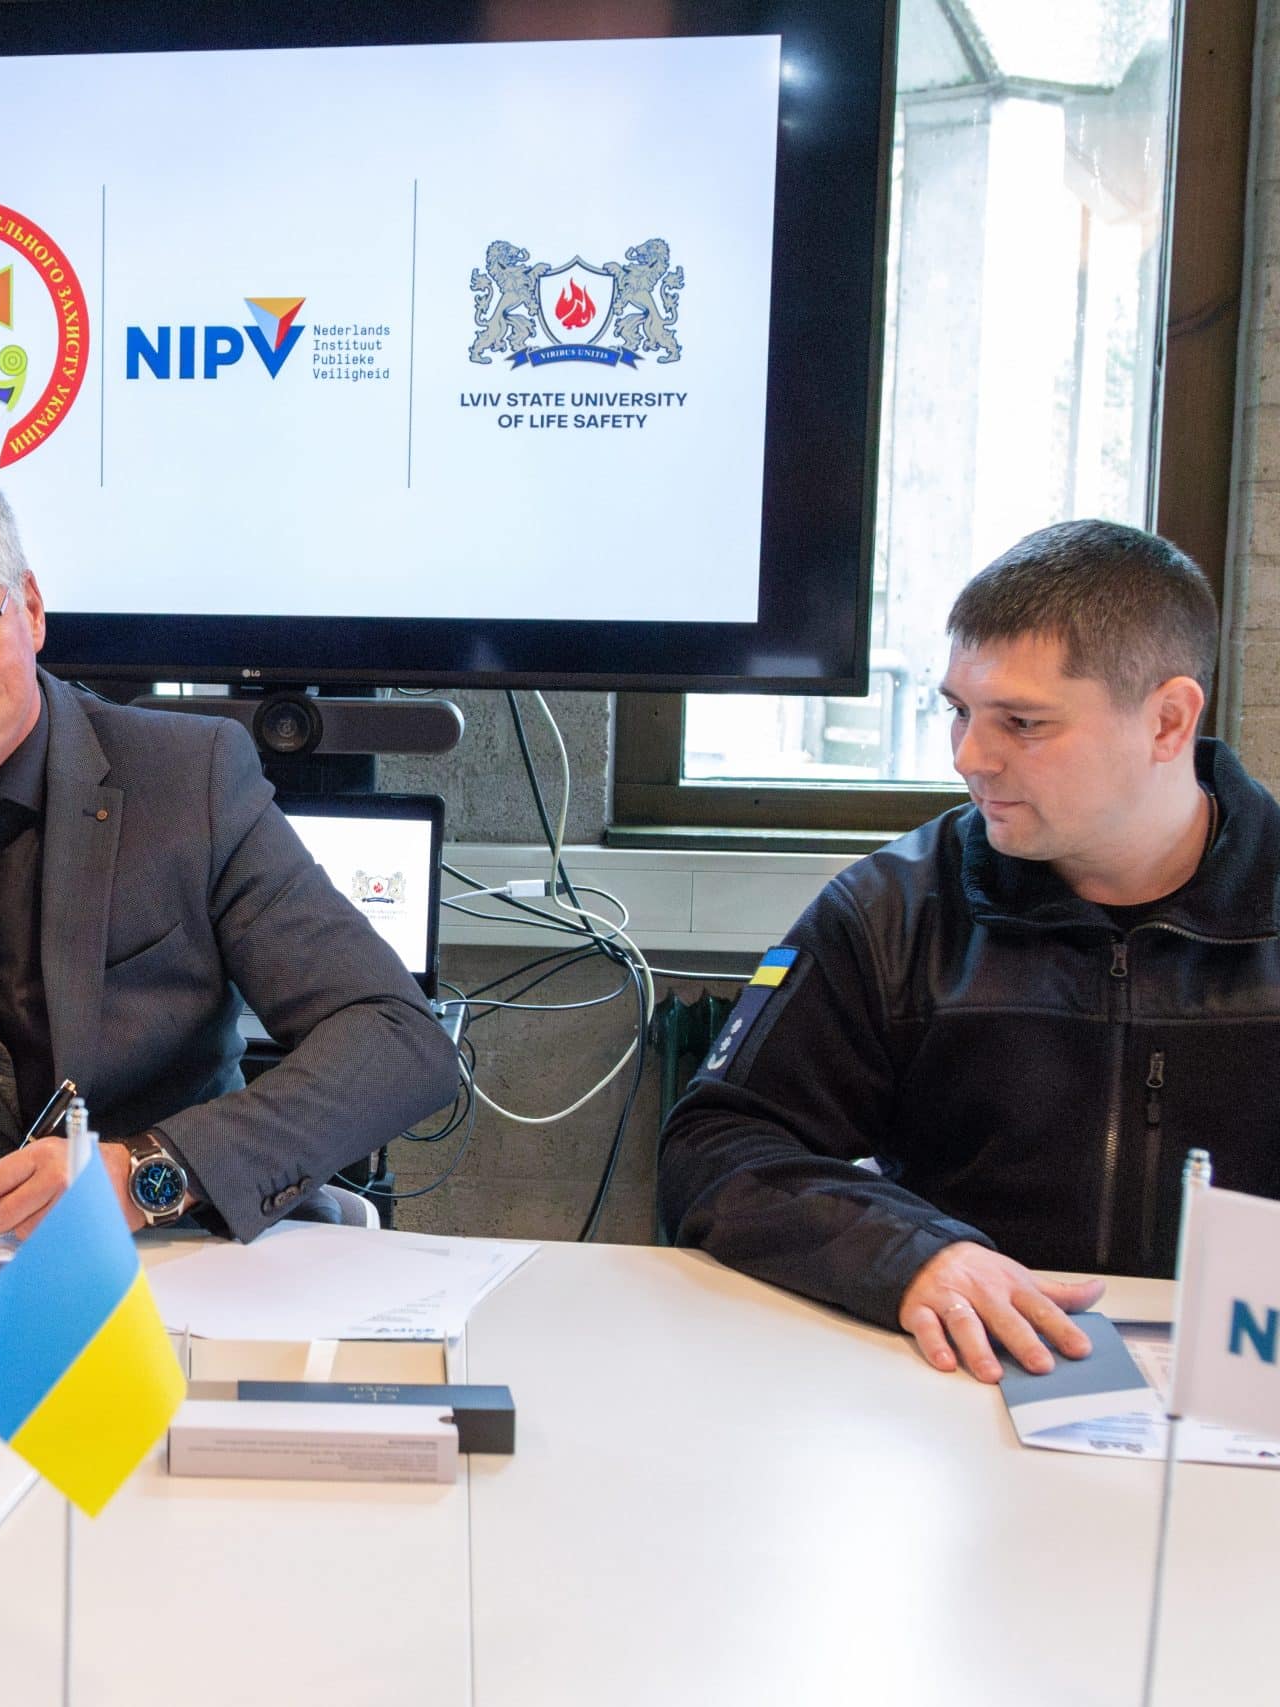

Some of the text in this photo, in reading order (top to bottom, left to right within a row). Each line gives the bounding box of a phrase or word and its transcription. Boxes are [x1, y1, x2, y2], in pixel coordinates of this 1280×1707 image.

[57, 287, 81, 382] ЗАХИСТУ
[313, 324, 391, 336] Nederlands
[313, 339, 383, 351] Instituut
[126, 325, 306, 380] NIPV
[313, 354, 375, 366] Publieke
[313, 368, 391, 382] Veiligheid
[460, 392, 688, 407] LVIV STATE UNIVERSITY
[9, 385, 71, 454] УКРАЇНИ
[497, 414, 648, 428] OF LIFE SAFETY
